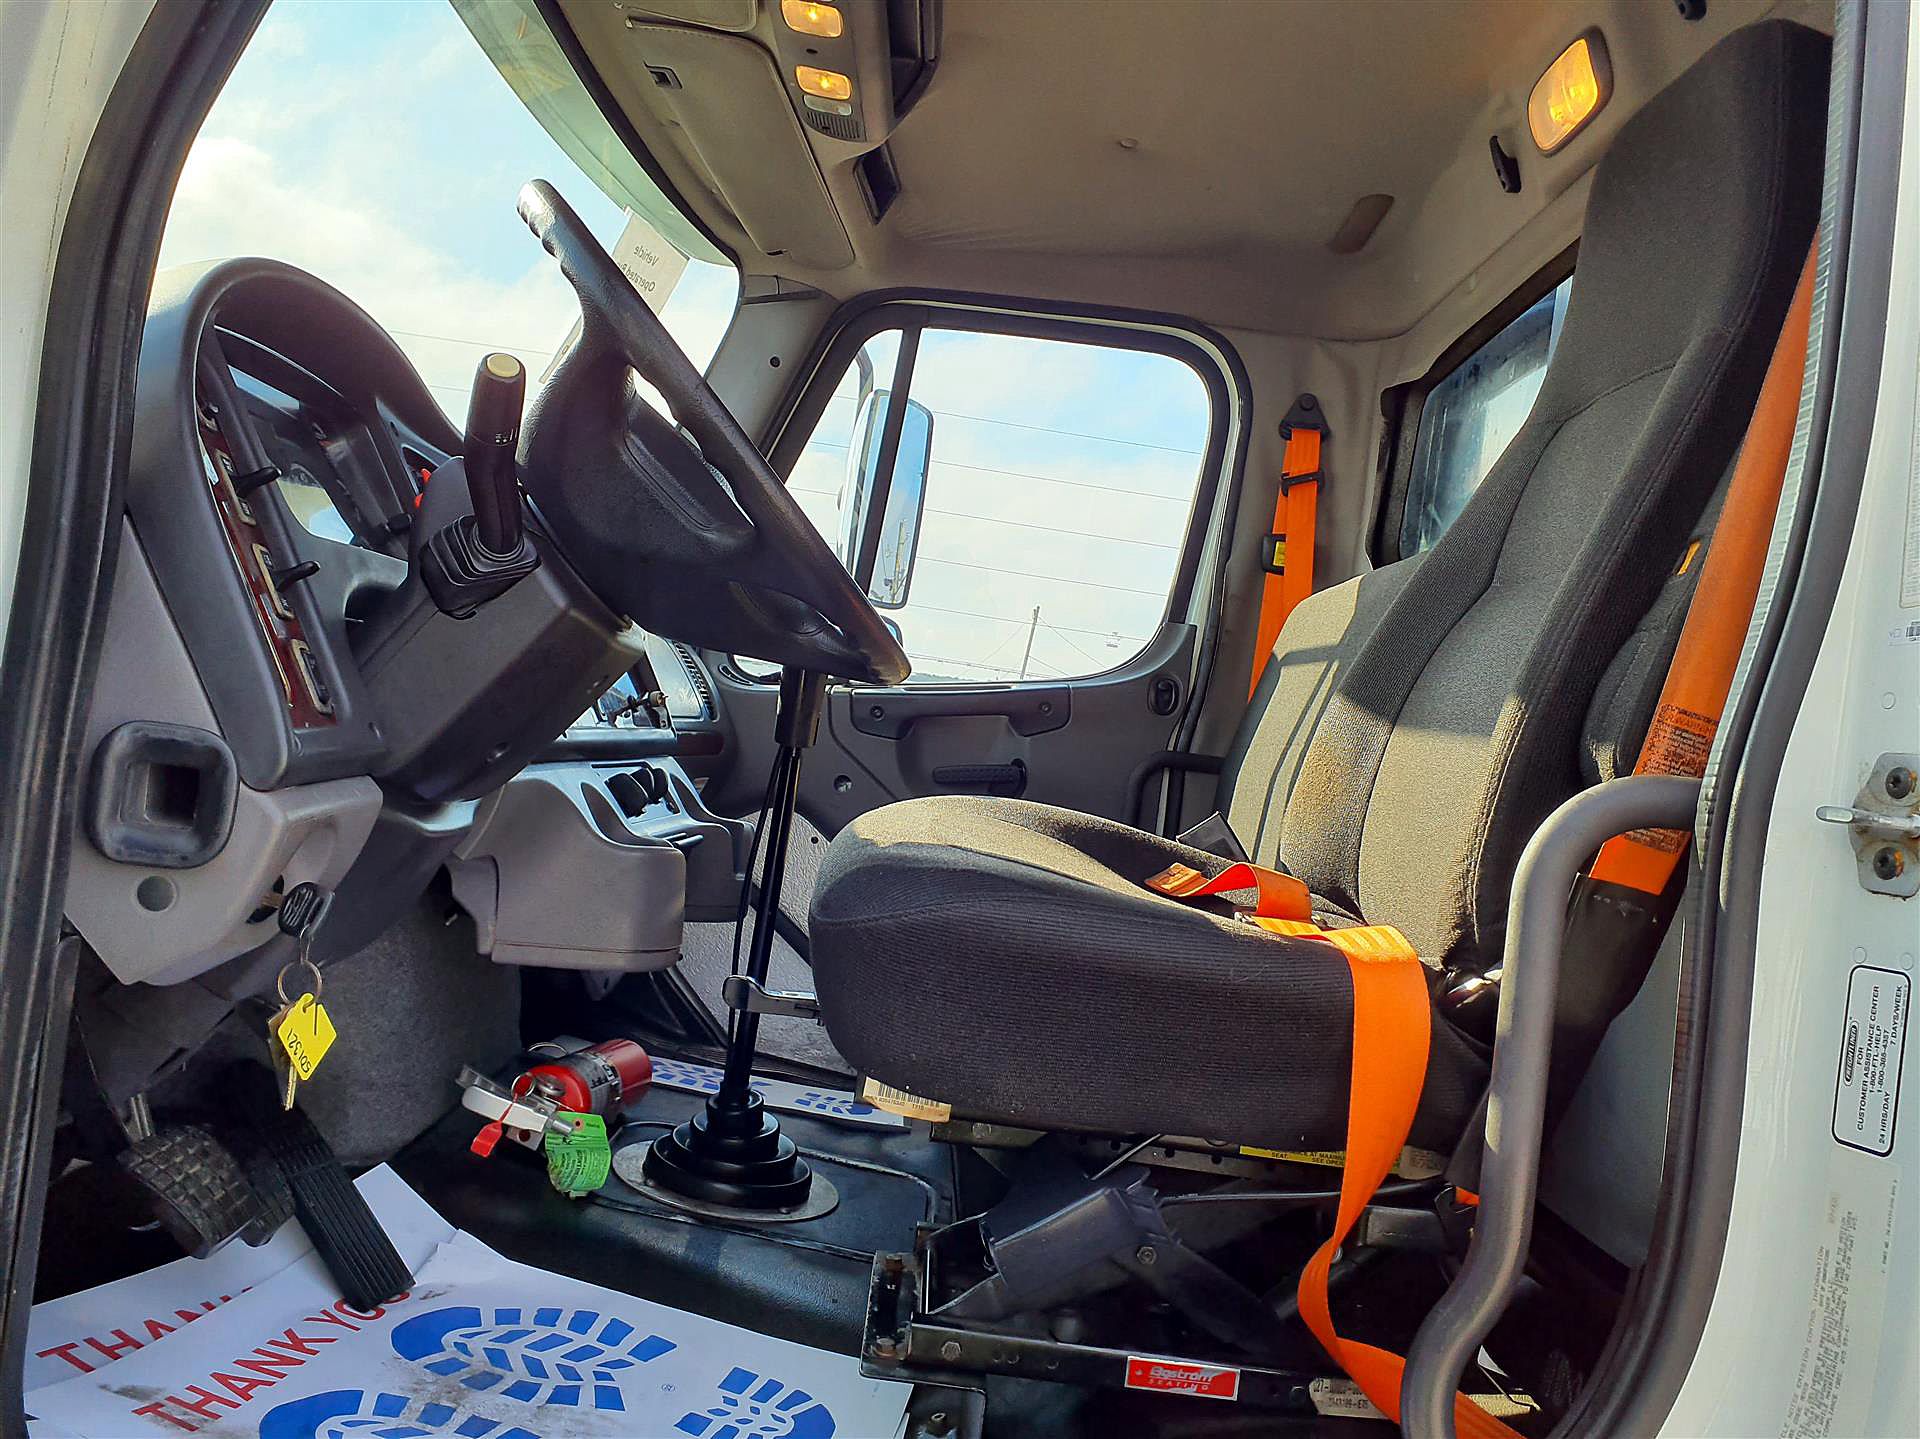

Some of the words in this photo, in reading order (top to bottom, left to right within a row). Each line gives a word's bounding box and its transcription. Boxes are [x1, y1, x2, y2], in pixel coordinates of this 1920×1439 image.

[1857, 1080, 1868, 1131] CUSTOMER
[1864, 1023, 1876, 1078] ASSISTANCE
[1870, 986, 1879, 1021] CENTER
[1869, 1025, 1881, 1092] 1-800-FTL-HELP
[1880, 1091, 1890, 1131] HRS/DAY
[1891, 986, 1902, 1039] DAYS/WEEK
[131, 1328, 339, 1433] THANK
